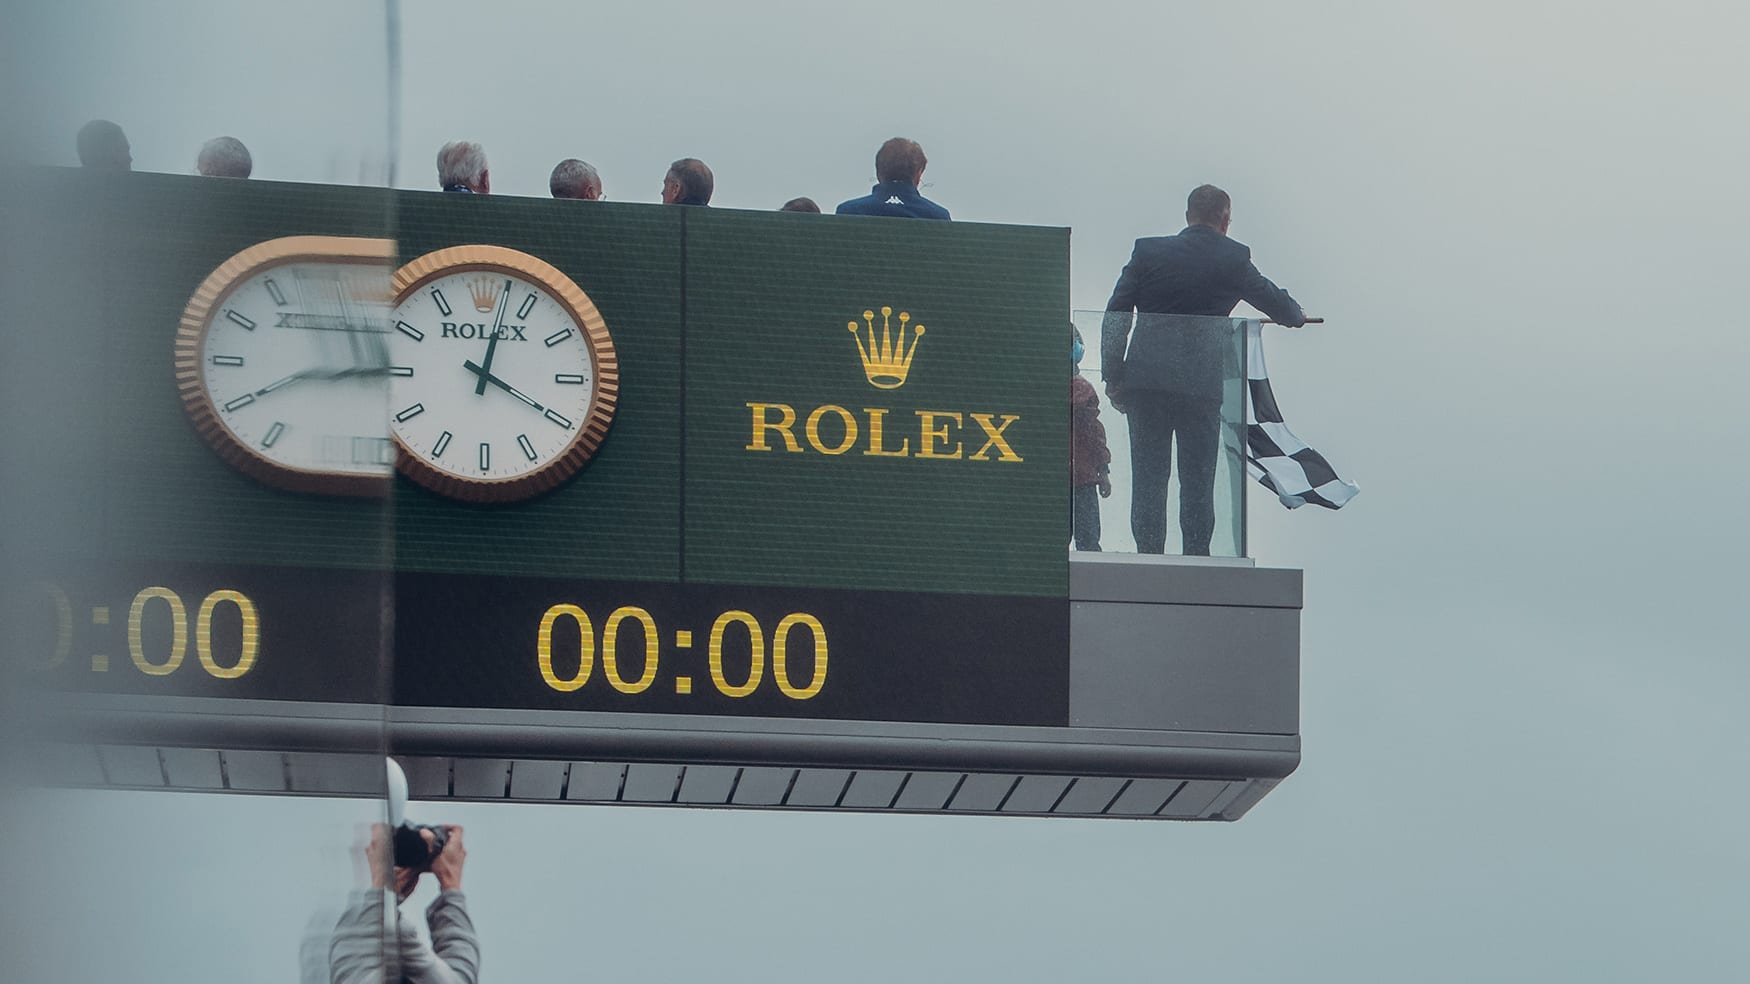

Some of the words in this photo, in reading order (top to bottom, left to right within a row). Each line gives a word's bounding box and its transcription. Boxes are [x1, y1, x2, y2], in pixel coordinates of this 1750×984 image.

[441, 322, 528, 342] ROLEX
[746, 402, 1023, 462] ROLEX
[537, 603, 828, 700] 00:00
